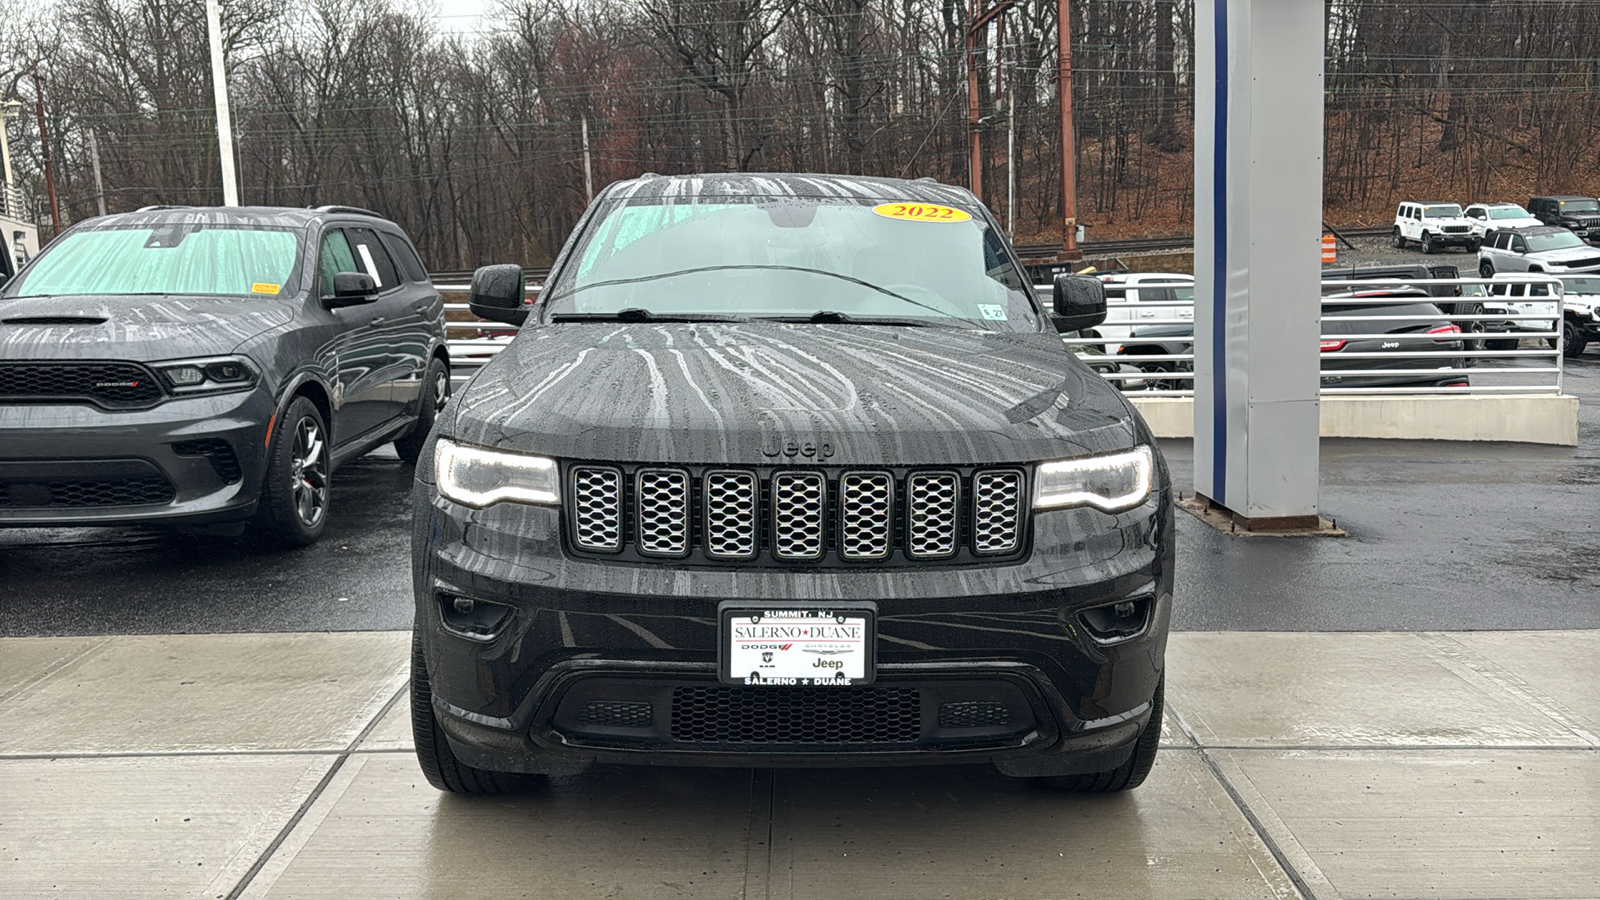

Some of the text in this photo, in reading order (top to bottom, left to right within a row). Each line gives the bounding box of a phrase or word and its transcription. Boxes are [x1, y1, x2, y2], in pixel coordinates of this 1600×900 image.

[892, 205, 954, 219] 2022
[1381, 341, 1400, 349] Jeep
[761, 437, 835, 462] Jeep
[817, 610, 834, 619] NJ
[735, 626, 861, 639] SALERNO DUANE
[812, 657, 844, 670] Jeep
[744, 677, 852, 686] SALERNO DUANE
